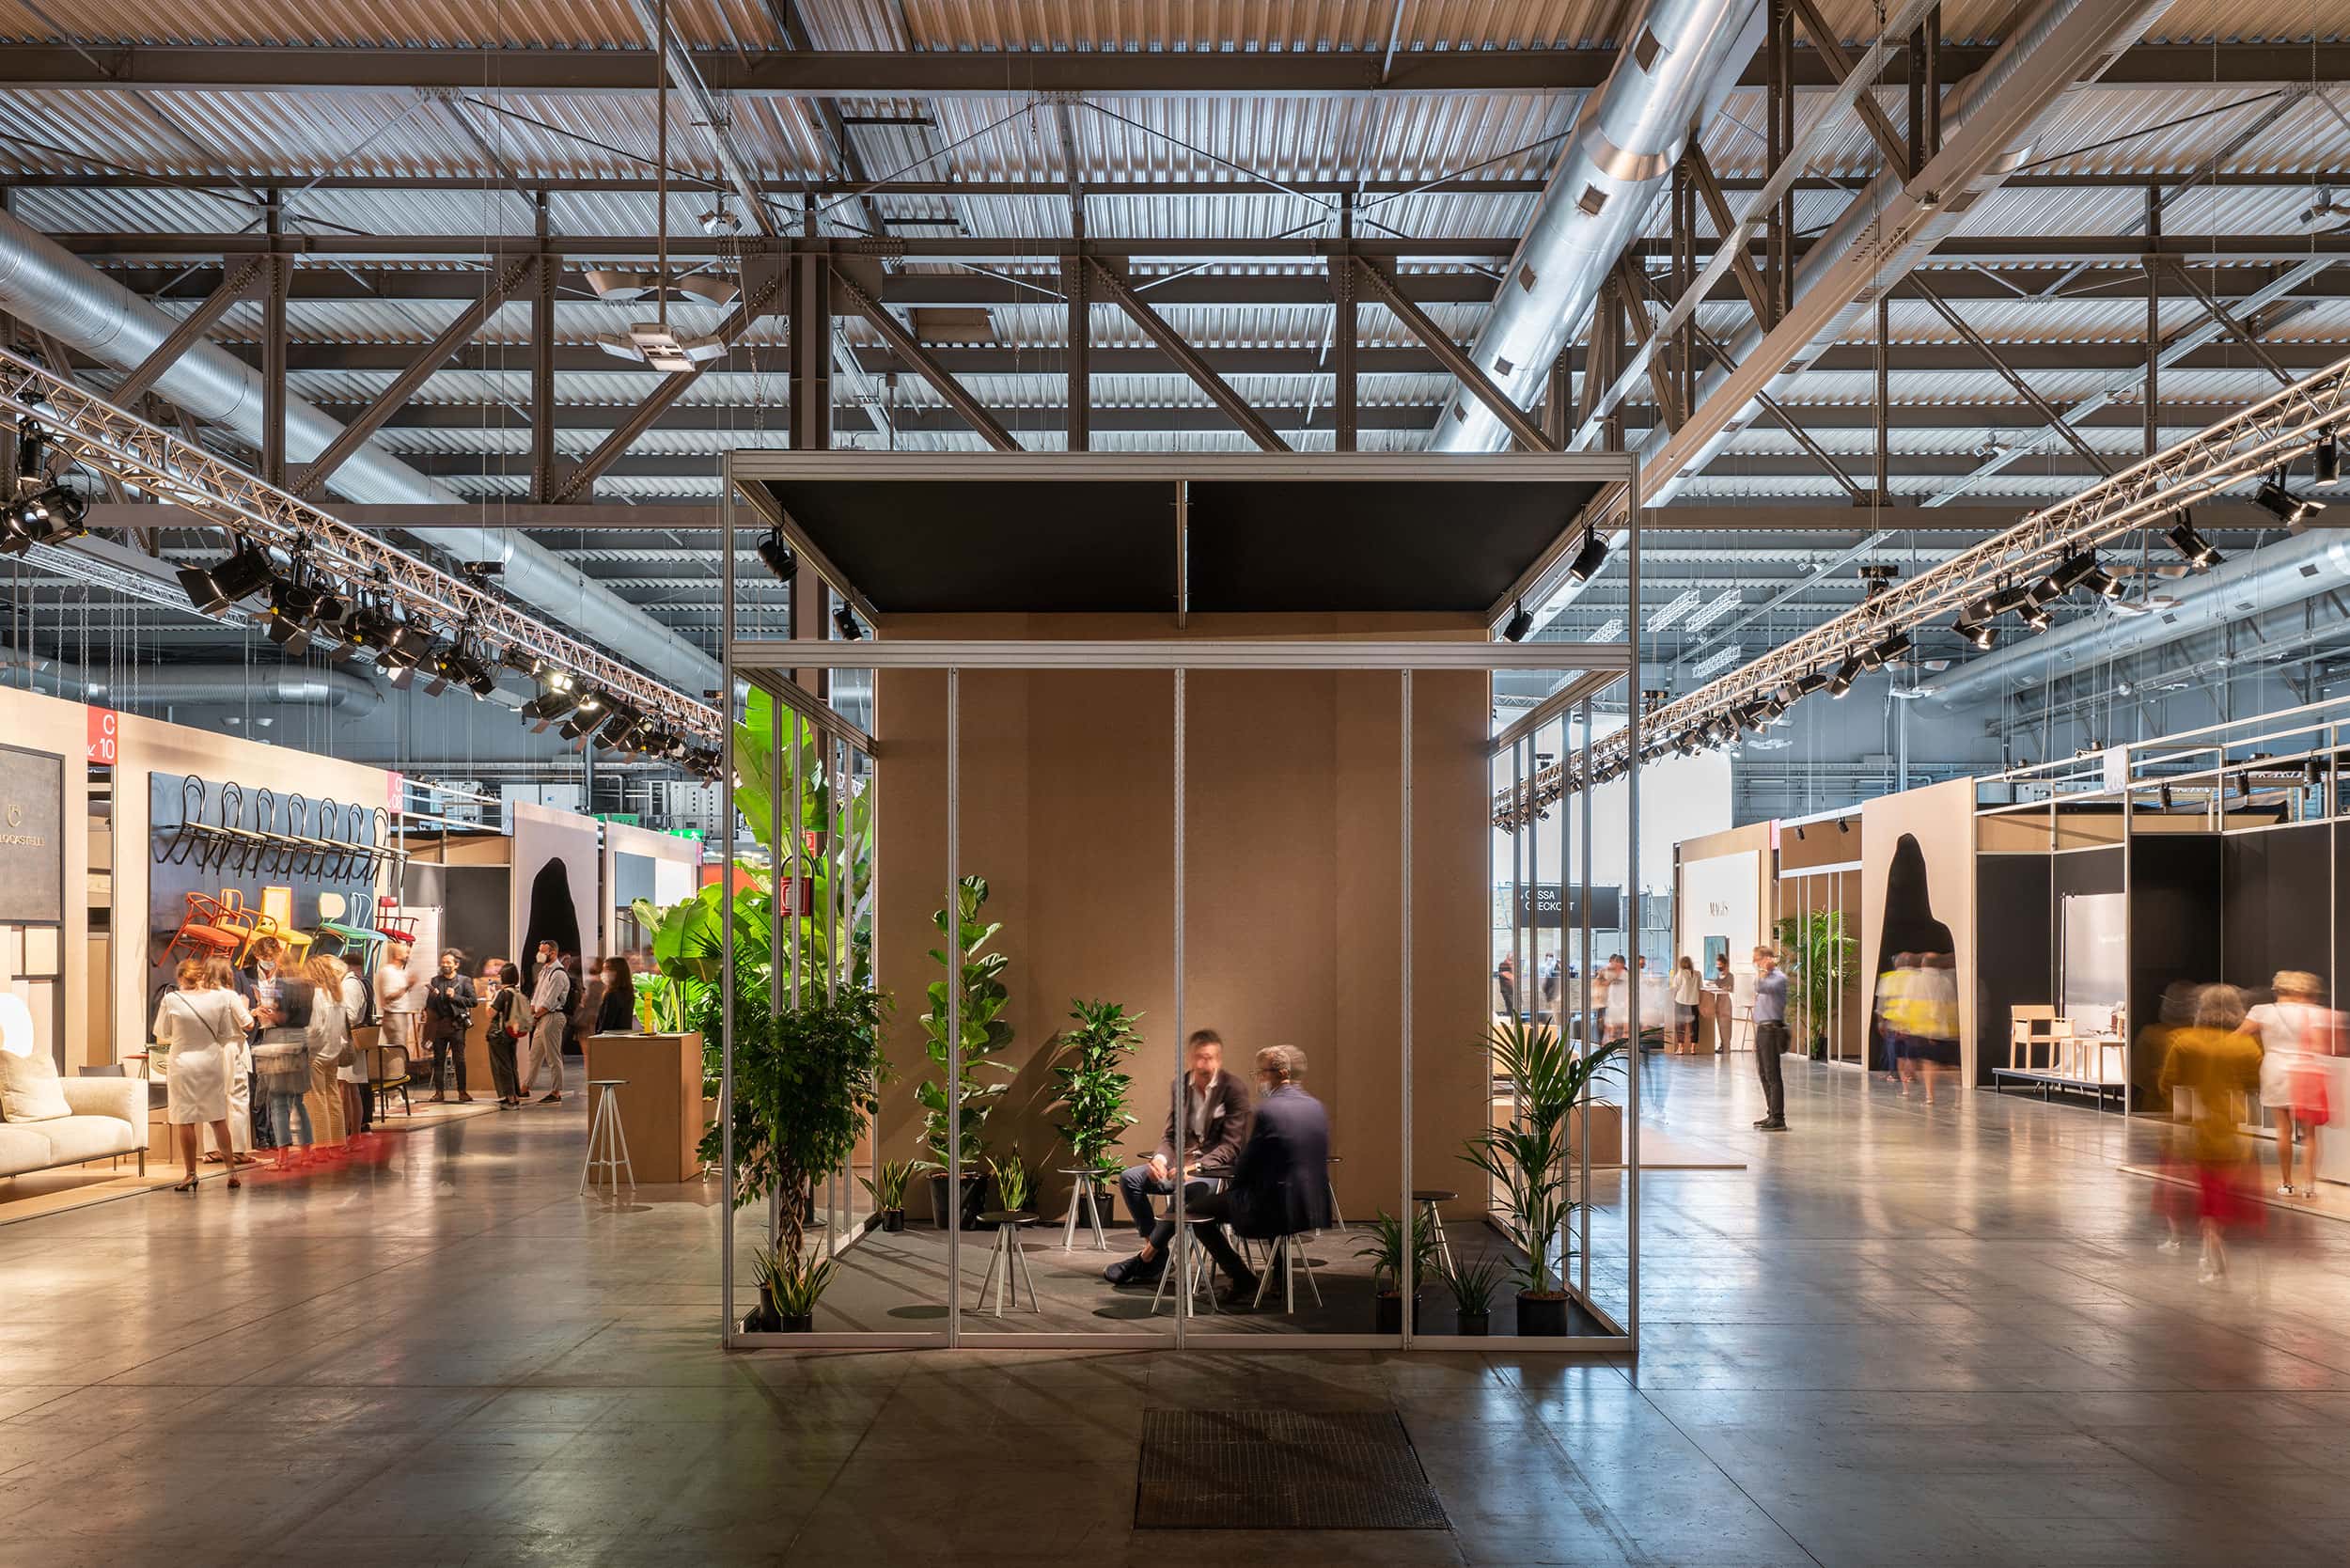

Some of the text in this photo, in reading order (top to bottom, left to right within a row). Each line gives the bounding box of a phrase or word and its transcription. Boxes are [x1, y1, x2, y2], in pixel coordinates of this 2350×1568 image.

[103, 714, 115, 735] C
[99, 737, 115, 759] 10
[1525, 889, 1556, 901] CSSA
[1525, 902, 1575, 911] CECKOT
